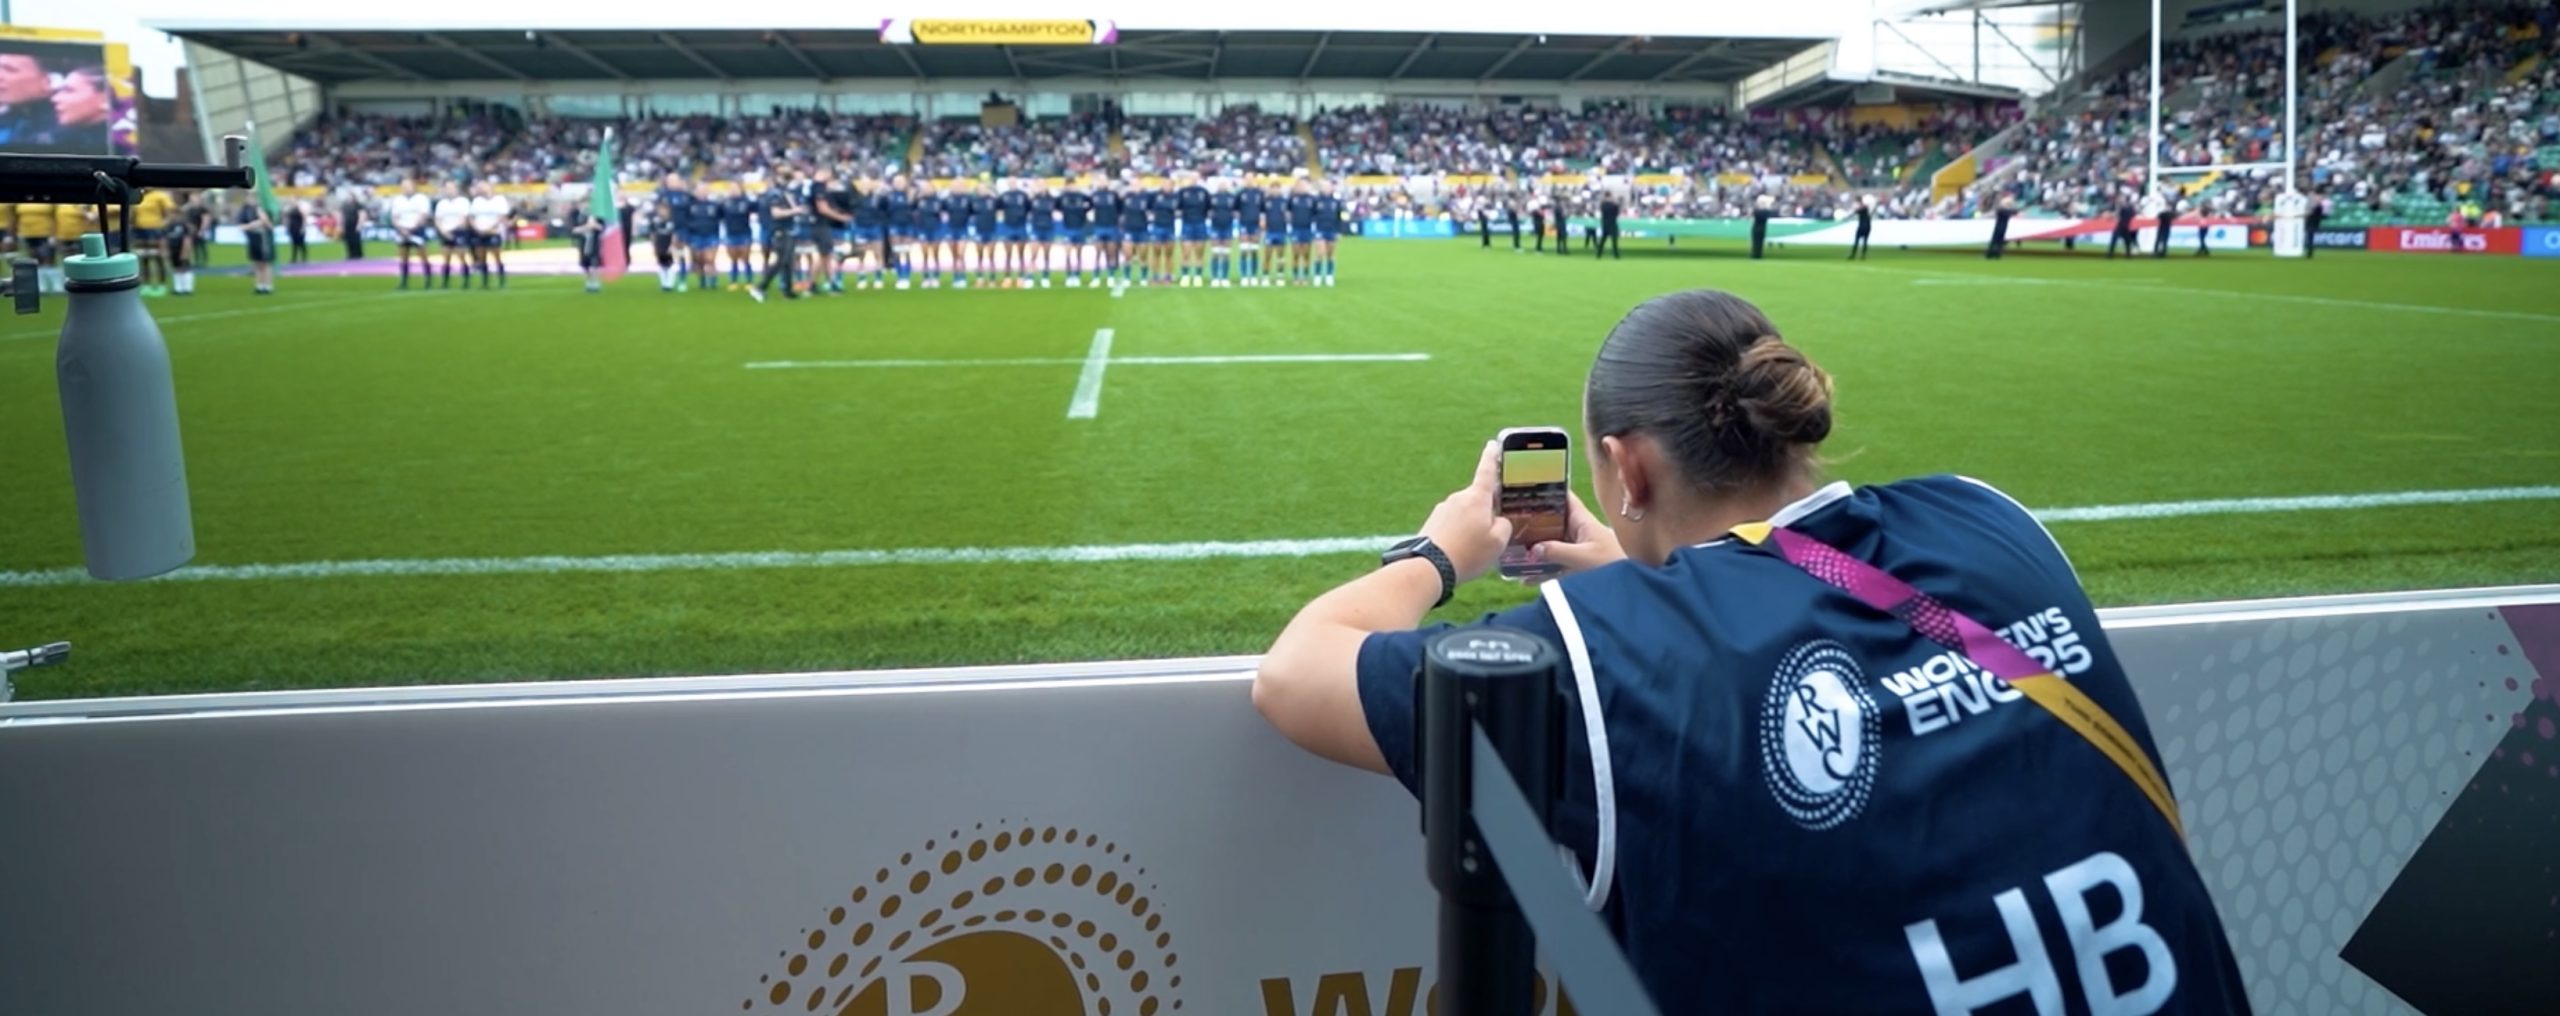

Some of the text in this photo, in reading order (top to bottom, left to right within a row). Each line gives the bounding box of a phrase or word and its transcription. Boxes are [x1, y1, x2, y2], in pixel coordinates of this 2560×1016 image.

[919, 22, 1087, 36] NORTHAMPTON
[1794, 684, 1857, 782] RWC
[1903, 851, 2178, 1016] HB
